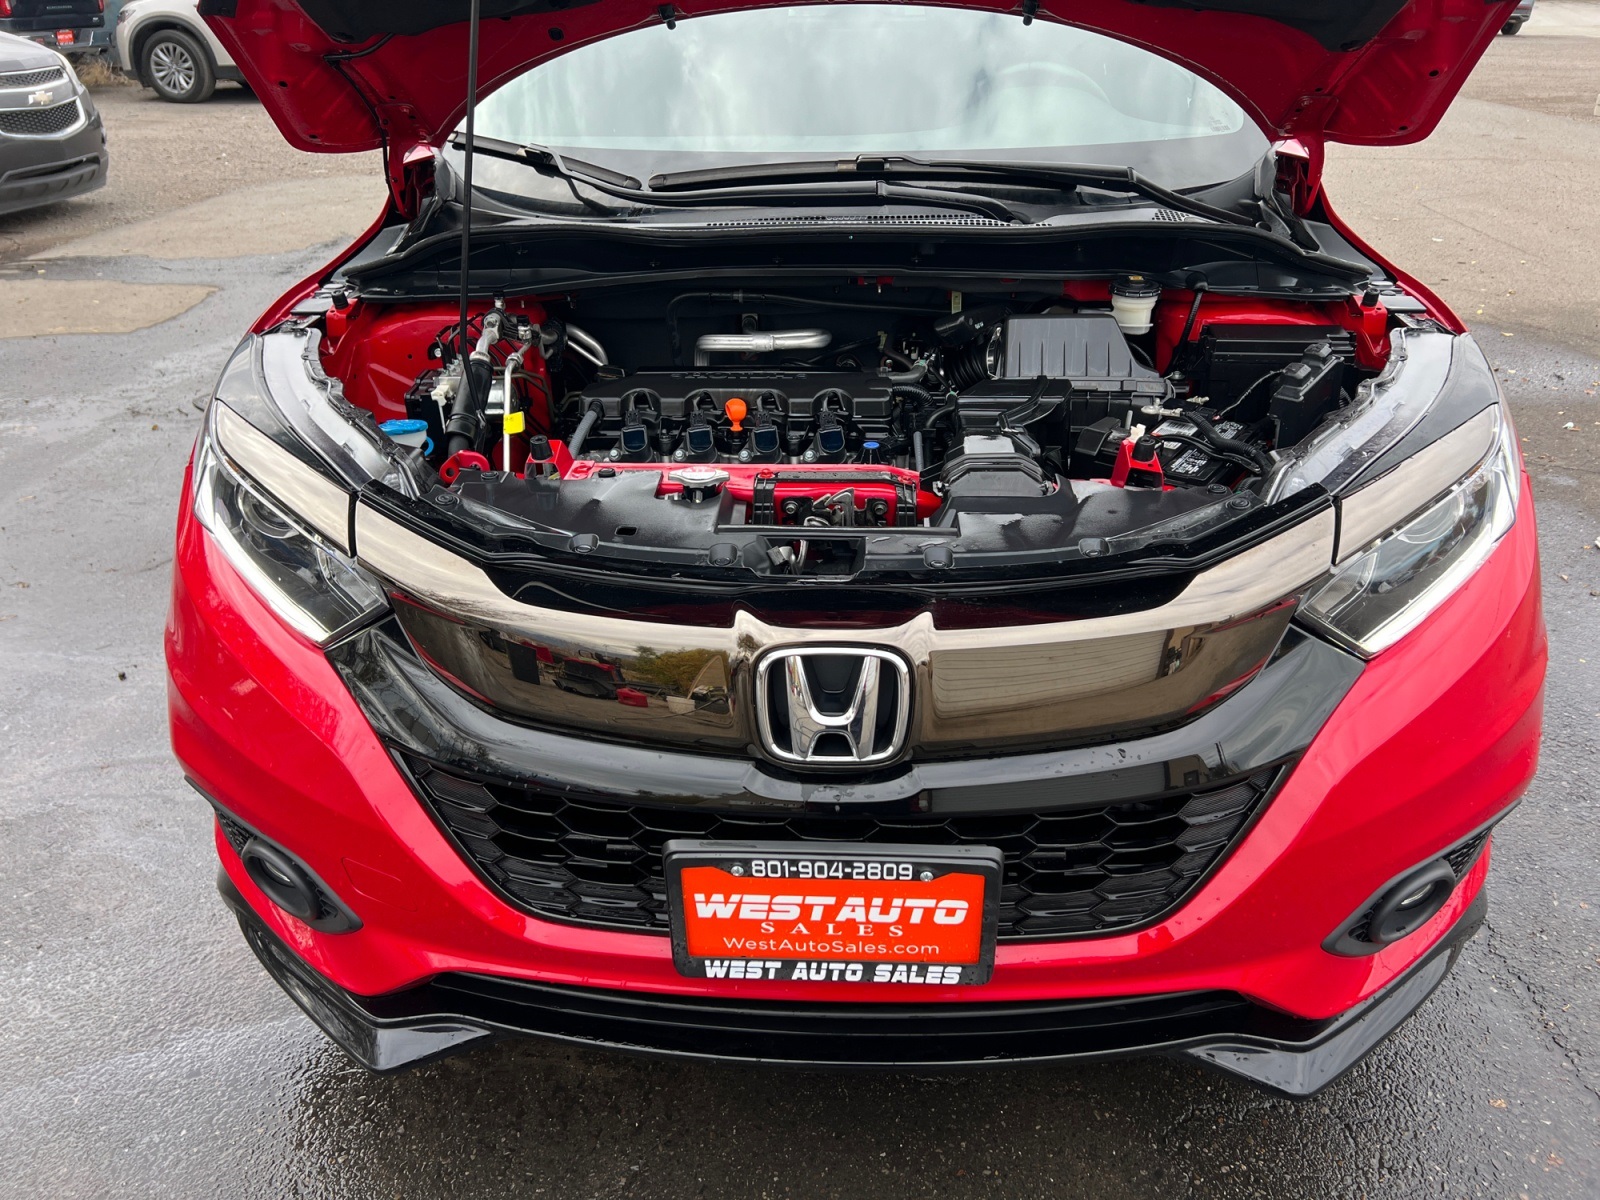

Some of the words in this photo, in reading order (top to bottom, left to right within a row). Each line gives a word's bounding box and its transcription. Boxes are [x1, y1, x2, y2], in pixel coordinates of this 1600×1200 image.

[751, 860, 913, 880] 801-904-2809
[694, 893, 836, 921] WEST
[835, 896, 969, 925] AUTO
[760, 921, 903, 937] SALES
[723, 937, 939, 954] WestAutoSales.com
[704, 959, 782, 980] WEST
[791, 961, 863, 982] AUTO
[873, 964, 963, 985] SALES
